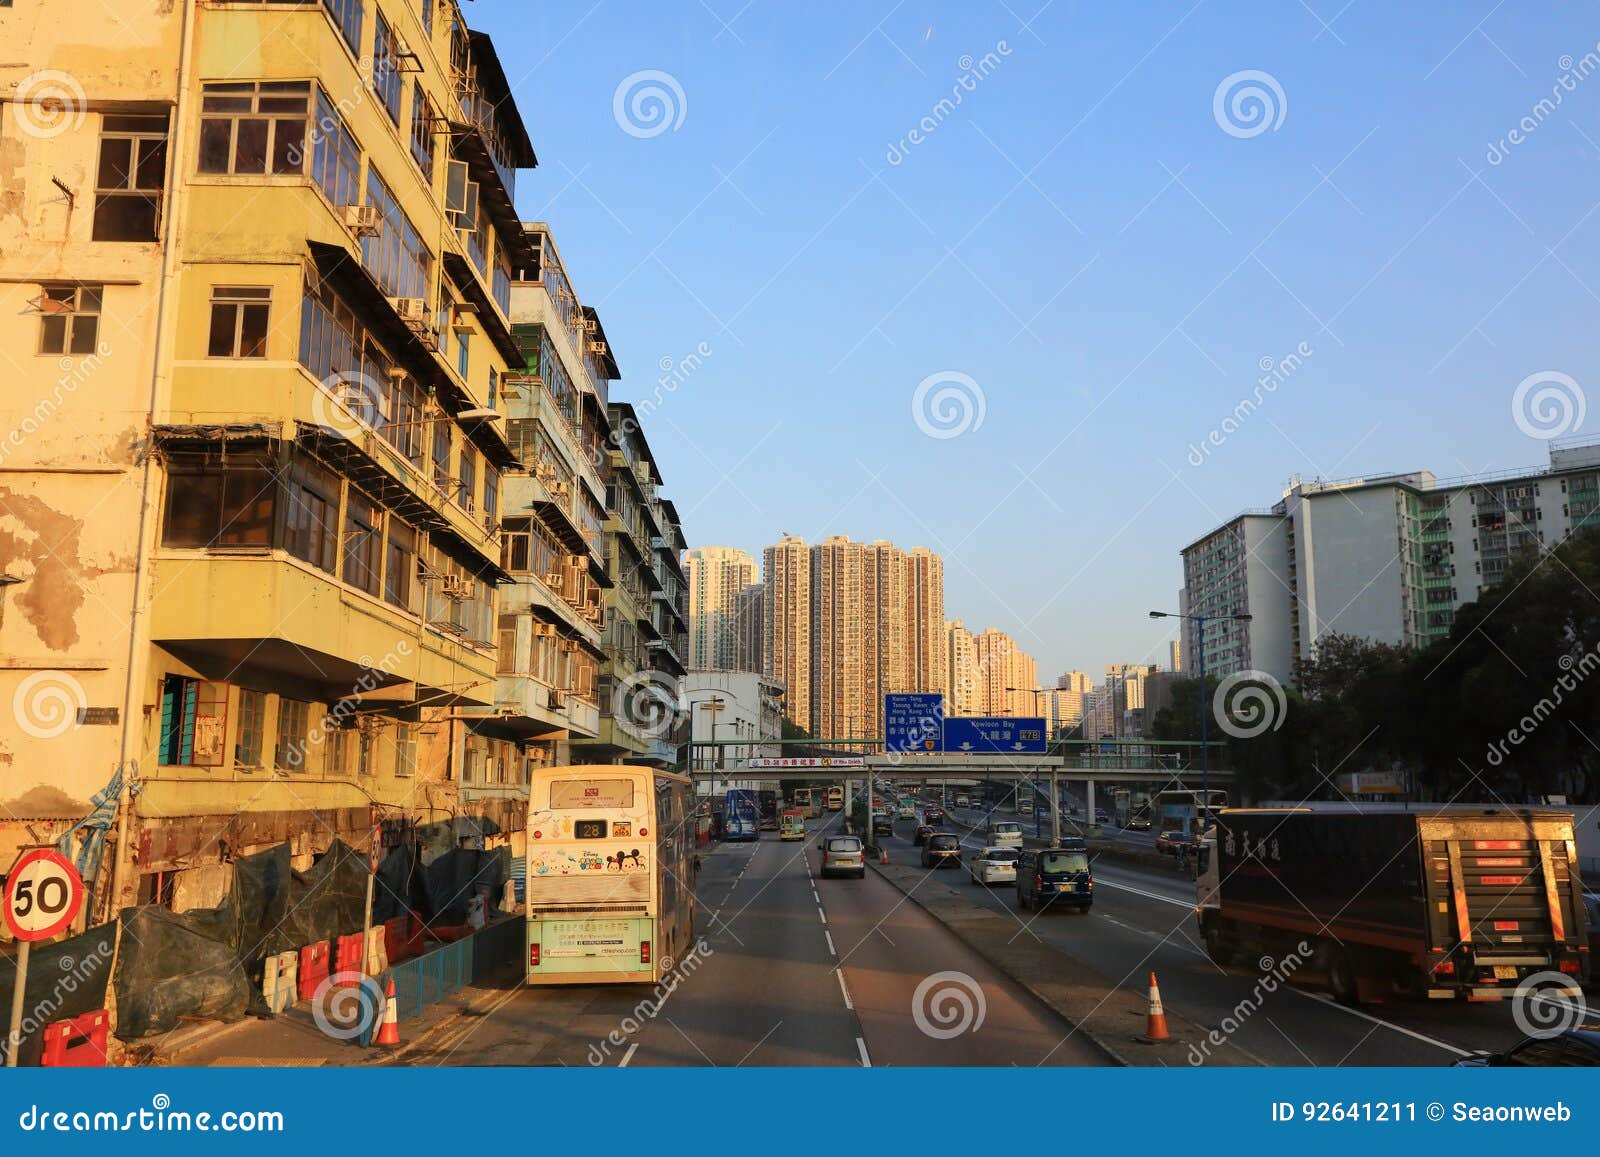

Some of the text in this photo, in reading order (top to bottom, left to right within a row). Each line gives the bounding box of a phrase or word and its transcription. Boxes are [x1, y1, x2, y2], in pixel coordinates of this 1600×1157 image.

[1003, 720, 1016, 729] Bay
[583, 824, 600, 837] 28
[14, 876, 68, 917] 50
